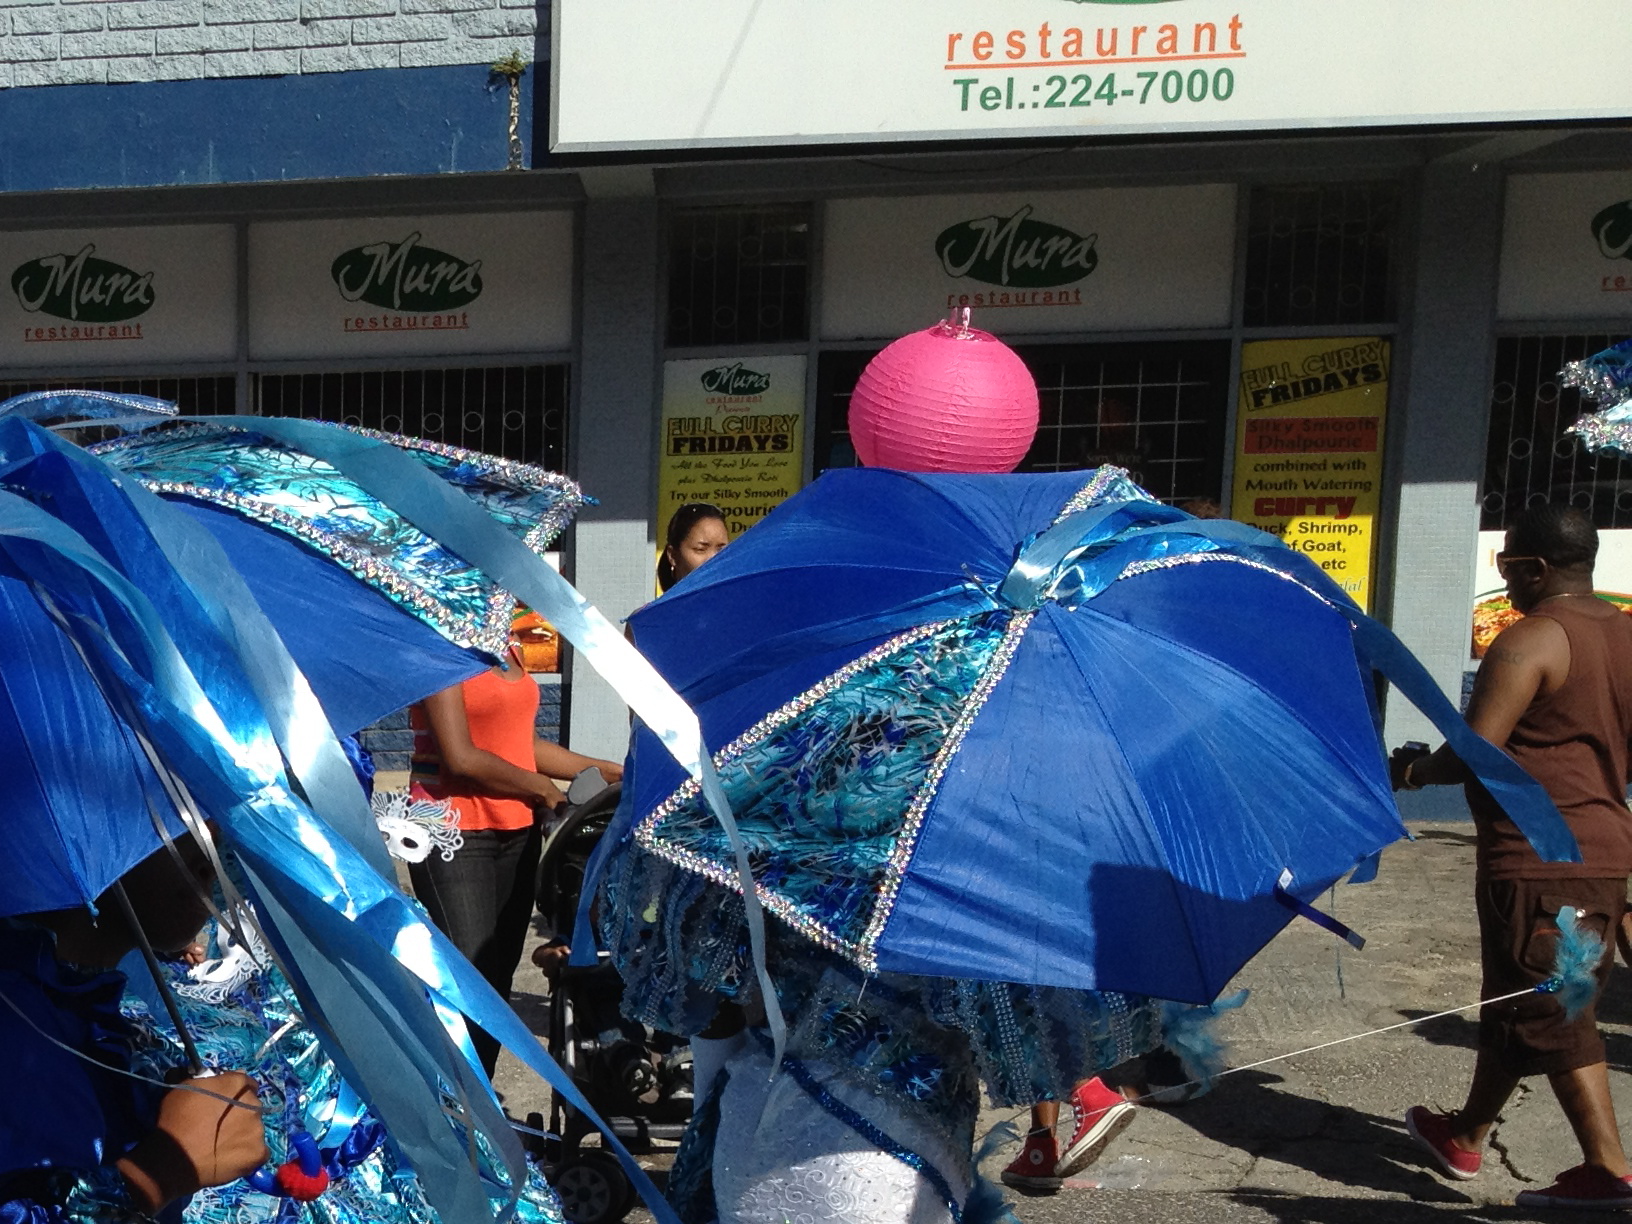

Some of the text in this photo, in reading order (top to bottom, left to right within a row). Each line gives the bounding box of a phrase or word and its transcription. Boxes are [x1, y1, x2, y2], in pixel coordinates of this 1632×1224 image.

[947, 14, 1243, 61] restaurant
[953, 68, 1235, 111] Tel.:224-7000
[943, 204, 1098, 286] Mura
[339, 231, 482, 310] Mura
[18, 243, 154, 320] Mura
[947, 288, 1081, 306] restaurant
[24, 323, 142, 339] restaurant
[344, 312, 468, 329] restaurant
[1240, 341, 1385, 391] FULL CURRY
[703, 362, 770, 395] Mura
[1252, 363, 1382, 408] FRIDAYS
[668, 414, 799, 436] FULL CURRY
[1248, 418, 1378, 434] Silky Smooth
[672, 434, 789, 454] FRIDAYS
[1253, 459, 1366, 472] combined with
[670, 487, 788, 501] Try our Silky Smooth
[1245, 479, 1372, 493] Mouth Watering
[1254, 496, 1357, 520] curry
[1298, 521, 1363, 536] Shrimp,
[1321, 559, 1347, 570] etc
